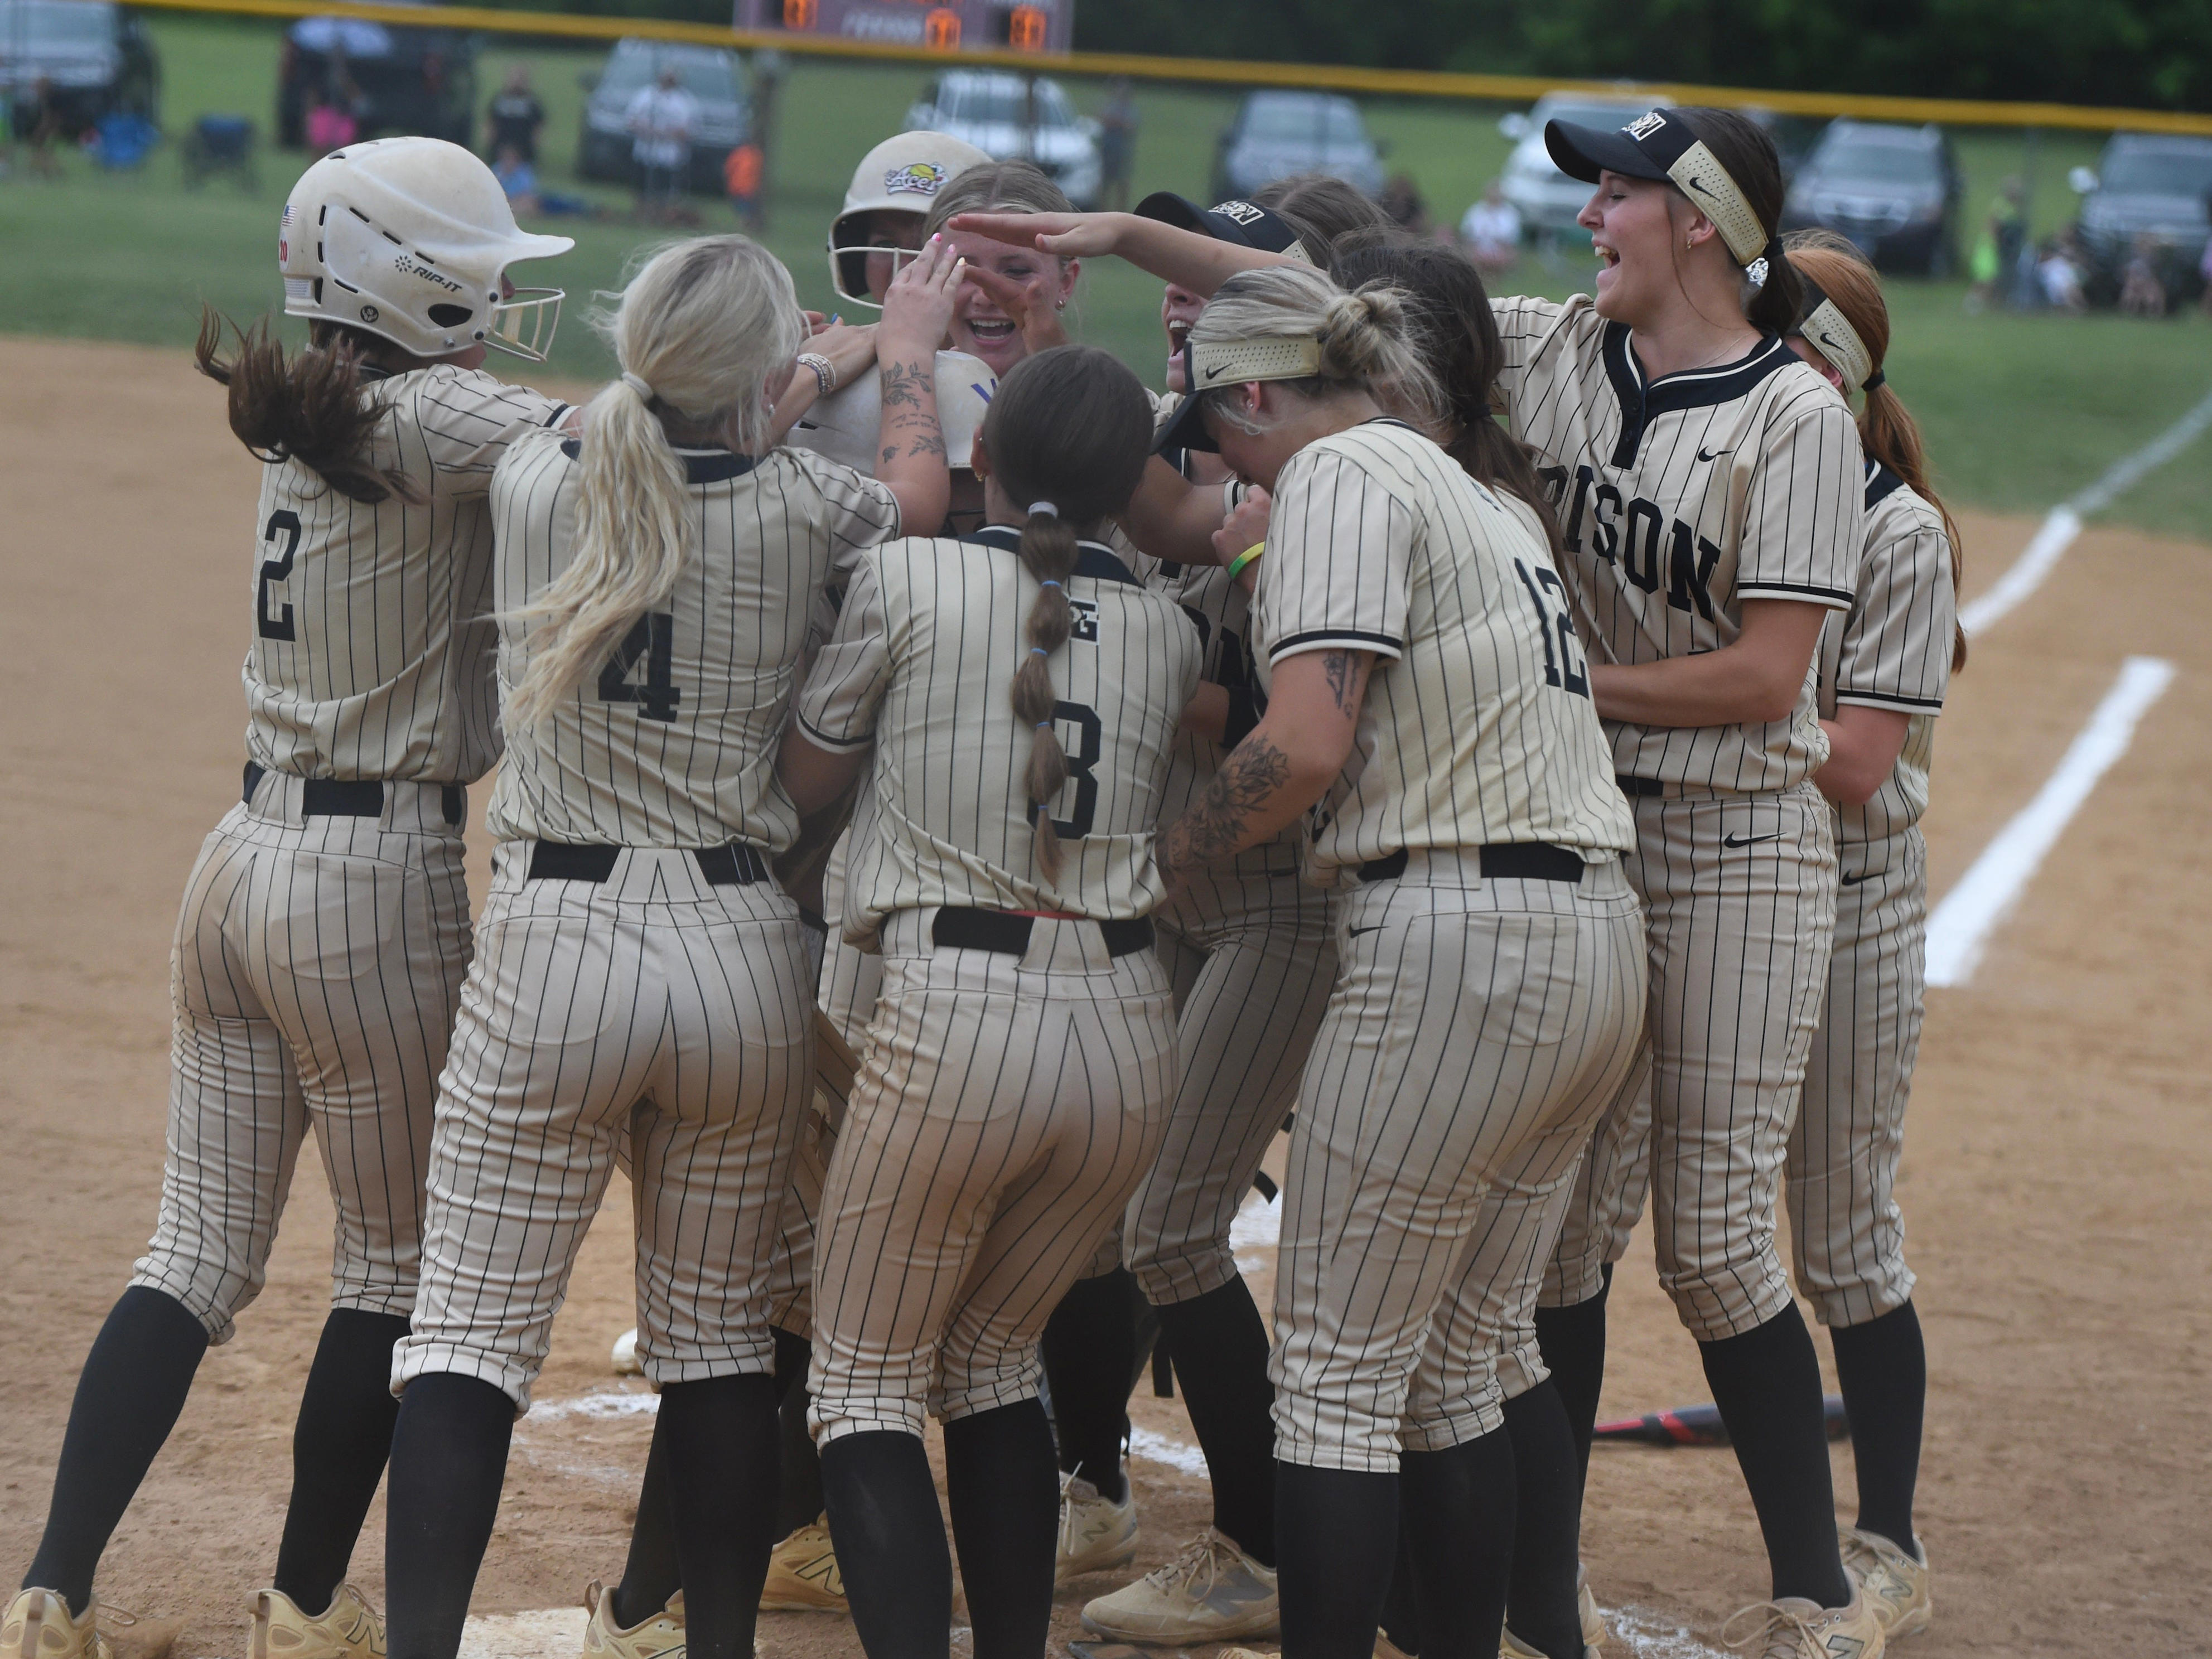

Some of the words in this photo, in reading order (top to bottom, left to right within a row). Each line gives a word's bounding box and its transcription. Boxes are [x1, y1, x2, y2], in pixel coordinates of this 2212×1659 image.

[413, 266, 462, 292] RIP-IT
[257, 509, 301, 642] 2
[1514, 557, 1589, 700] 12
[598, 611, 680, 723] 4
[1026, 699, 1102, 840] 8
